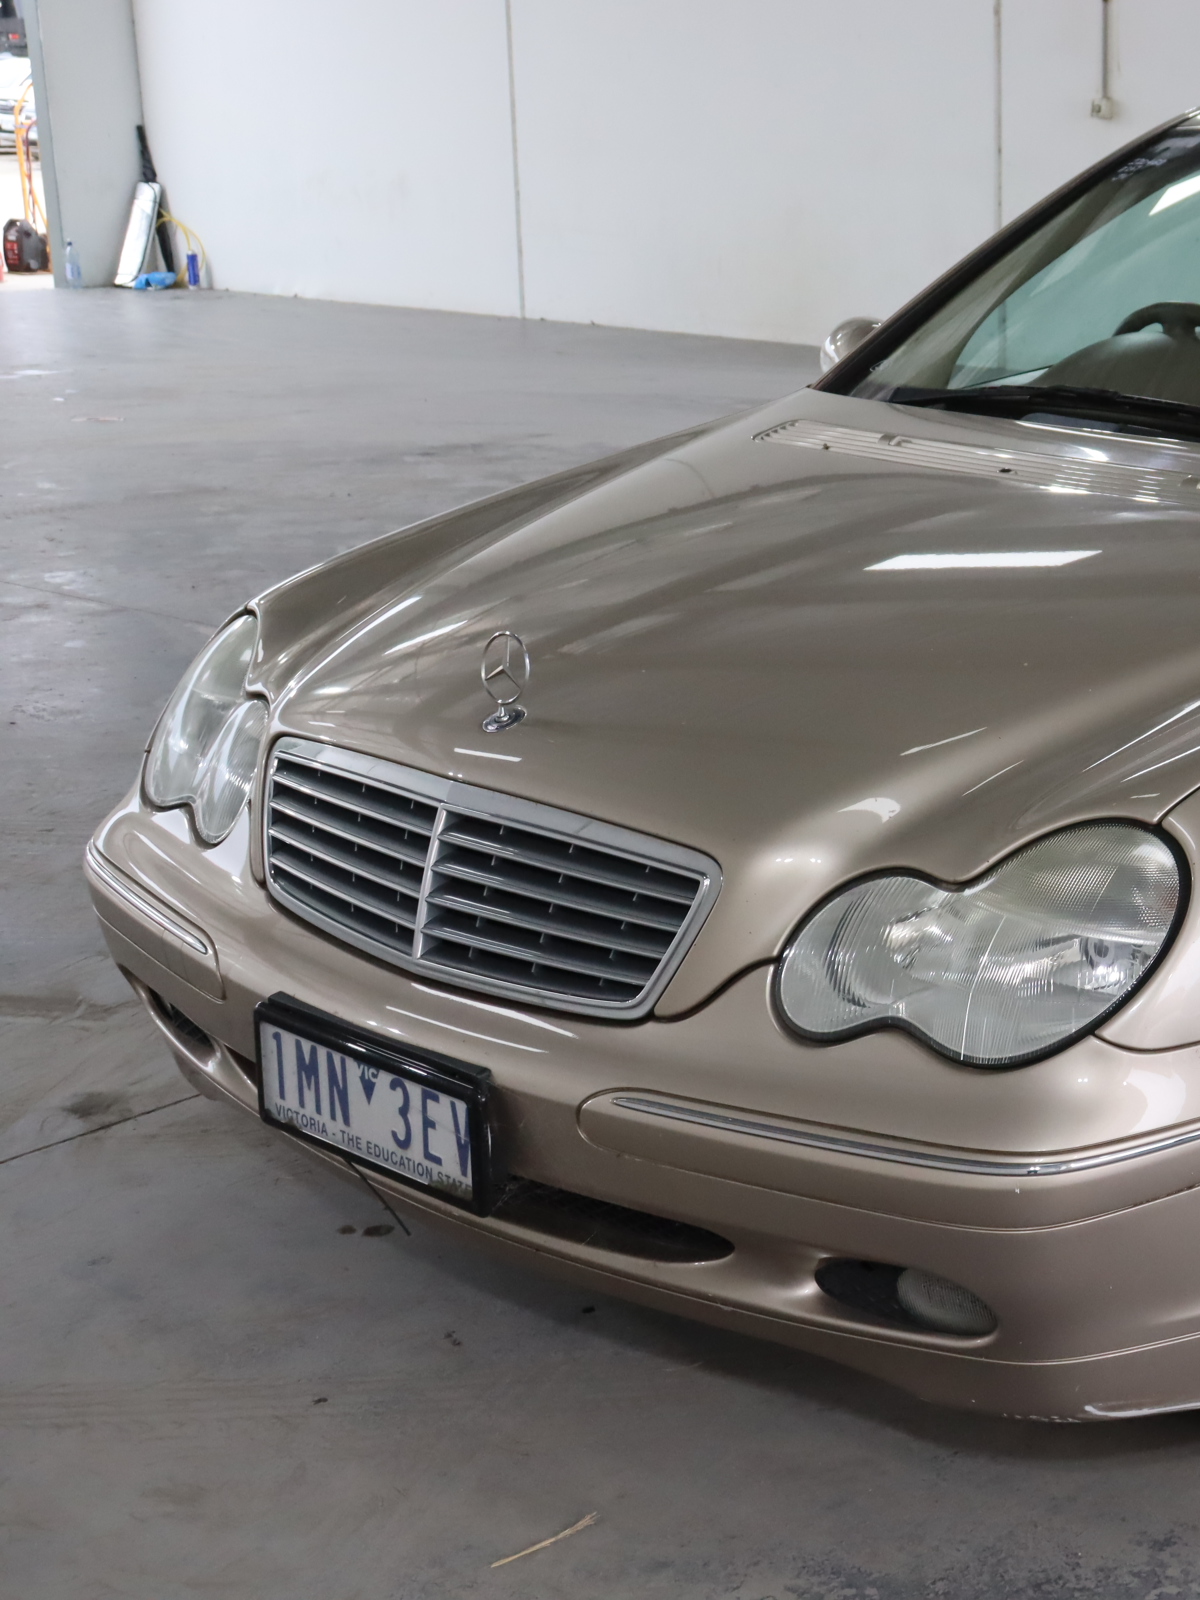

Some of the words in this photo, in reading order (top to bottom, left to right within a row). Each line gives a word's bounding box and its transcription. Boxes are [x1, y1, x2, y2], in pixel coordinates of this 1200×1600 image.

[272, 1031, 351, 1127] 1MN
[389, 1077, 470, 1178] 3EV
[357, 1063, 378, 1083] VIC
[275, 1102, 328, 1136] VICTORIA
[340, 1129, 362, 1151] THE
[366, 1140, 432, 1181] EDUCATION
